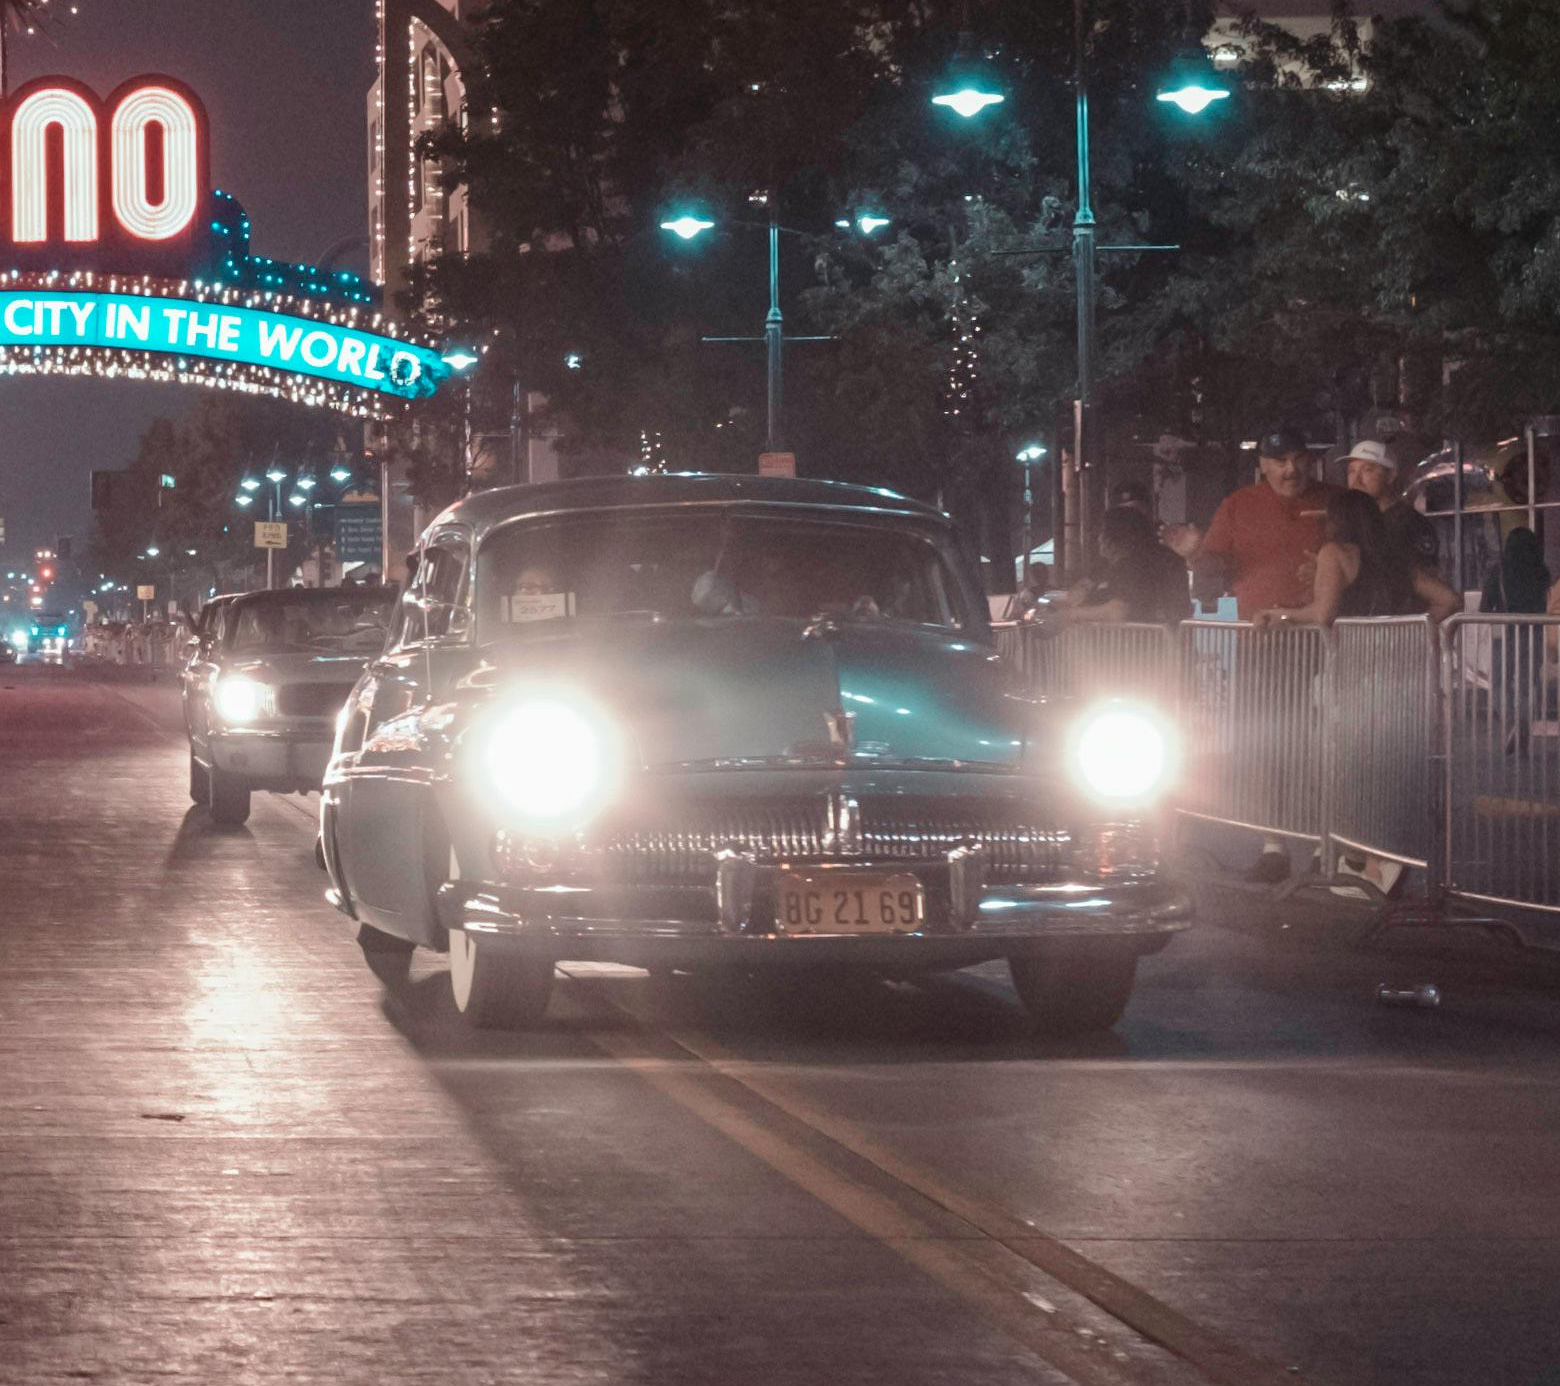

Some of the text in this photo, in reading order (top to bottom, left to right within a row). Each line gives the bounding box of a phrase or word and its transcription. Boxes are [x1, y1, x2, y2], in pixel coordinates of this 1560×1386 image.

[4, 299, 96, 336] CITY
[105, 303, 150, 341] IN
[163, 308, 242, 352] THE
[258, 320, 421, 386] WORLD
[833, 890, 870, 925] 21
[882, 890, 916, 924] 69
